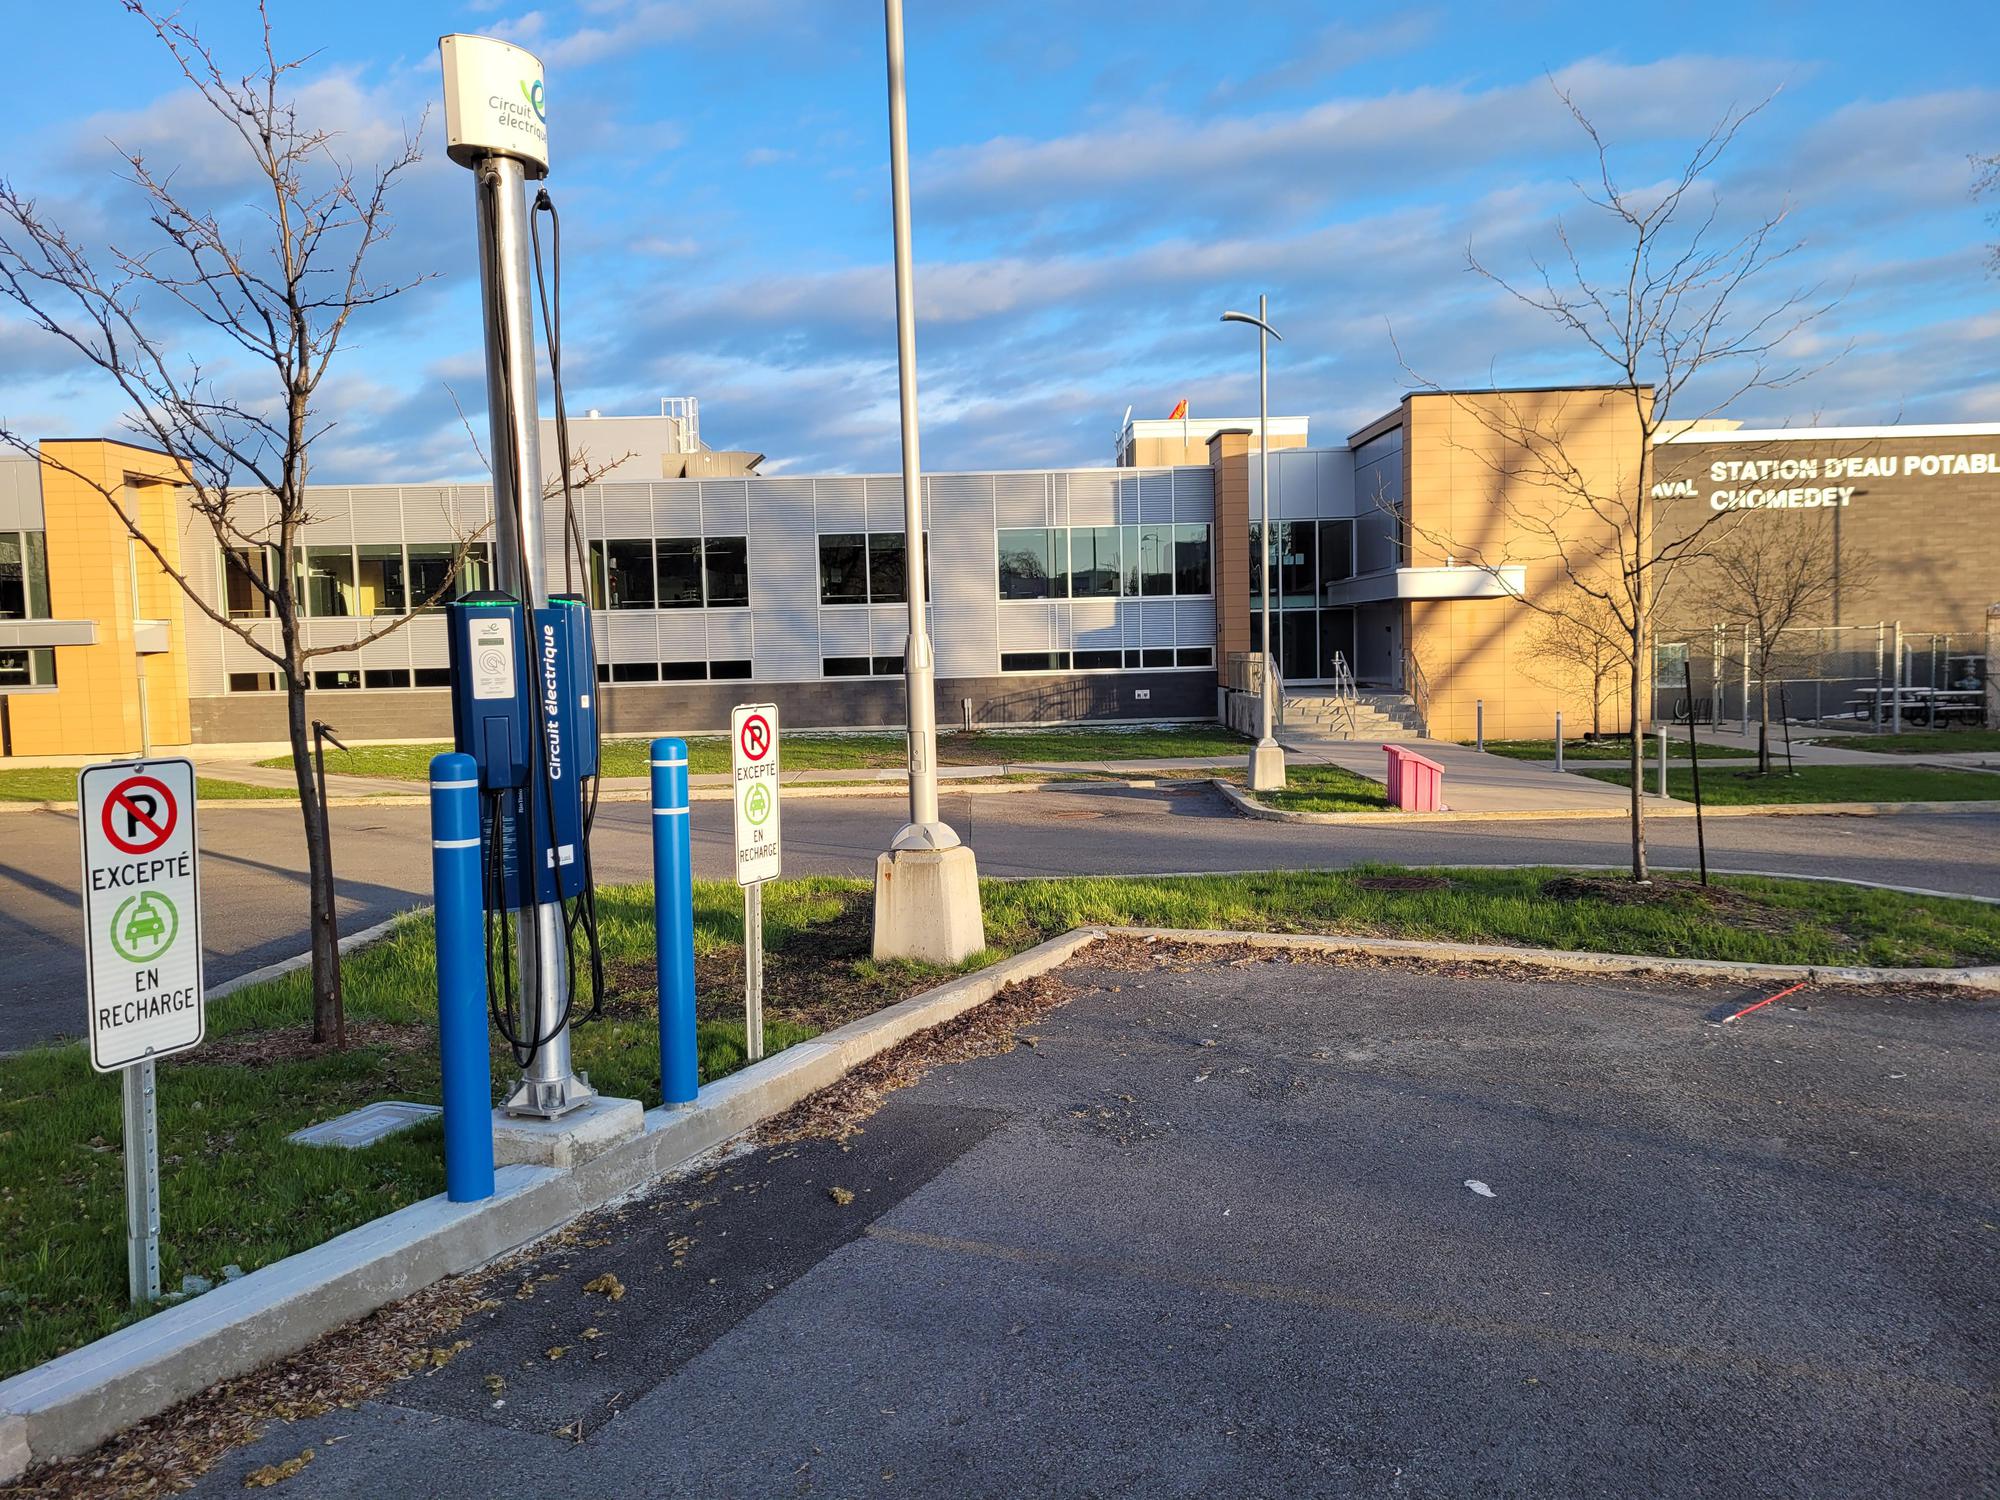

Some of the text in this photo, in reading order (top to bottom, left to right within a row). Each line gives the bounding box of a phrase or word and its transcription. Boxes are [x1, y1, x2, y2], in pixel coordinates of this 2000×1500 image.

[488, 95, 532, 119] Circuit
[1710, 453, 2000, 482] STATION D'EAU POTABL
[1710, 486, 1855, 510] CHOMEDEY
[543, 624, 561, 780] Circuit électrique
[737, 760, 776, 781] EXCEPTÉ
[753, 829, 764, 843] EN
[739, 842, 777, 863] RECHARGE
[92, 850, 191, 891] EXCEPTÉ
[135, 967, 159, 993] EN
[99, 987, 195, 1031] RECHARGE
